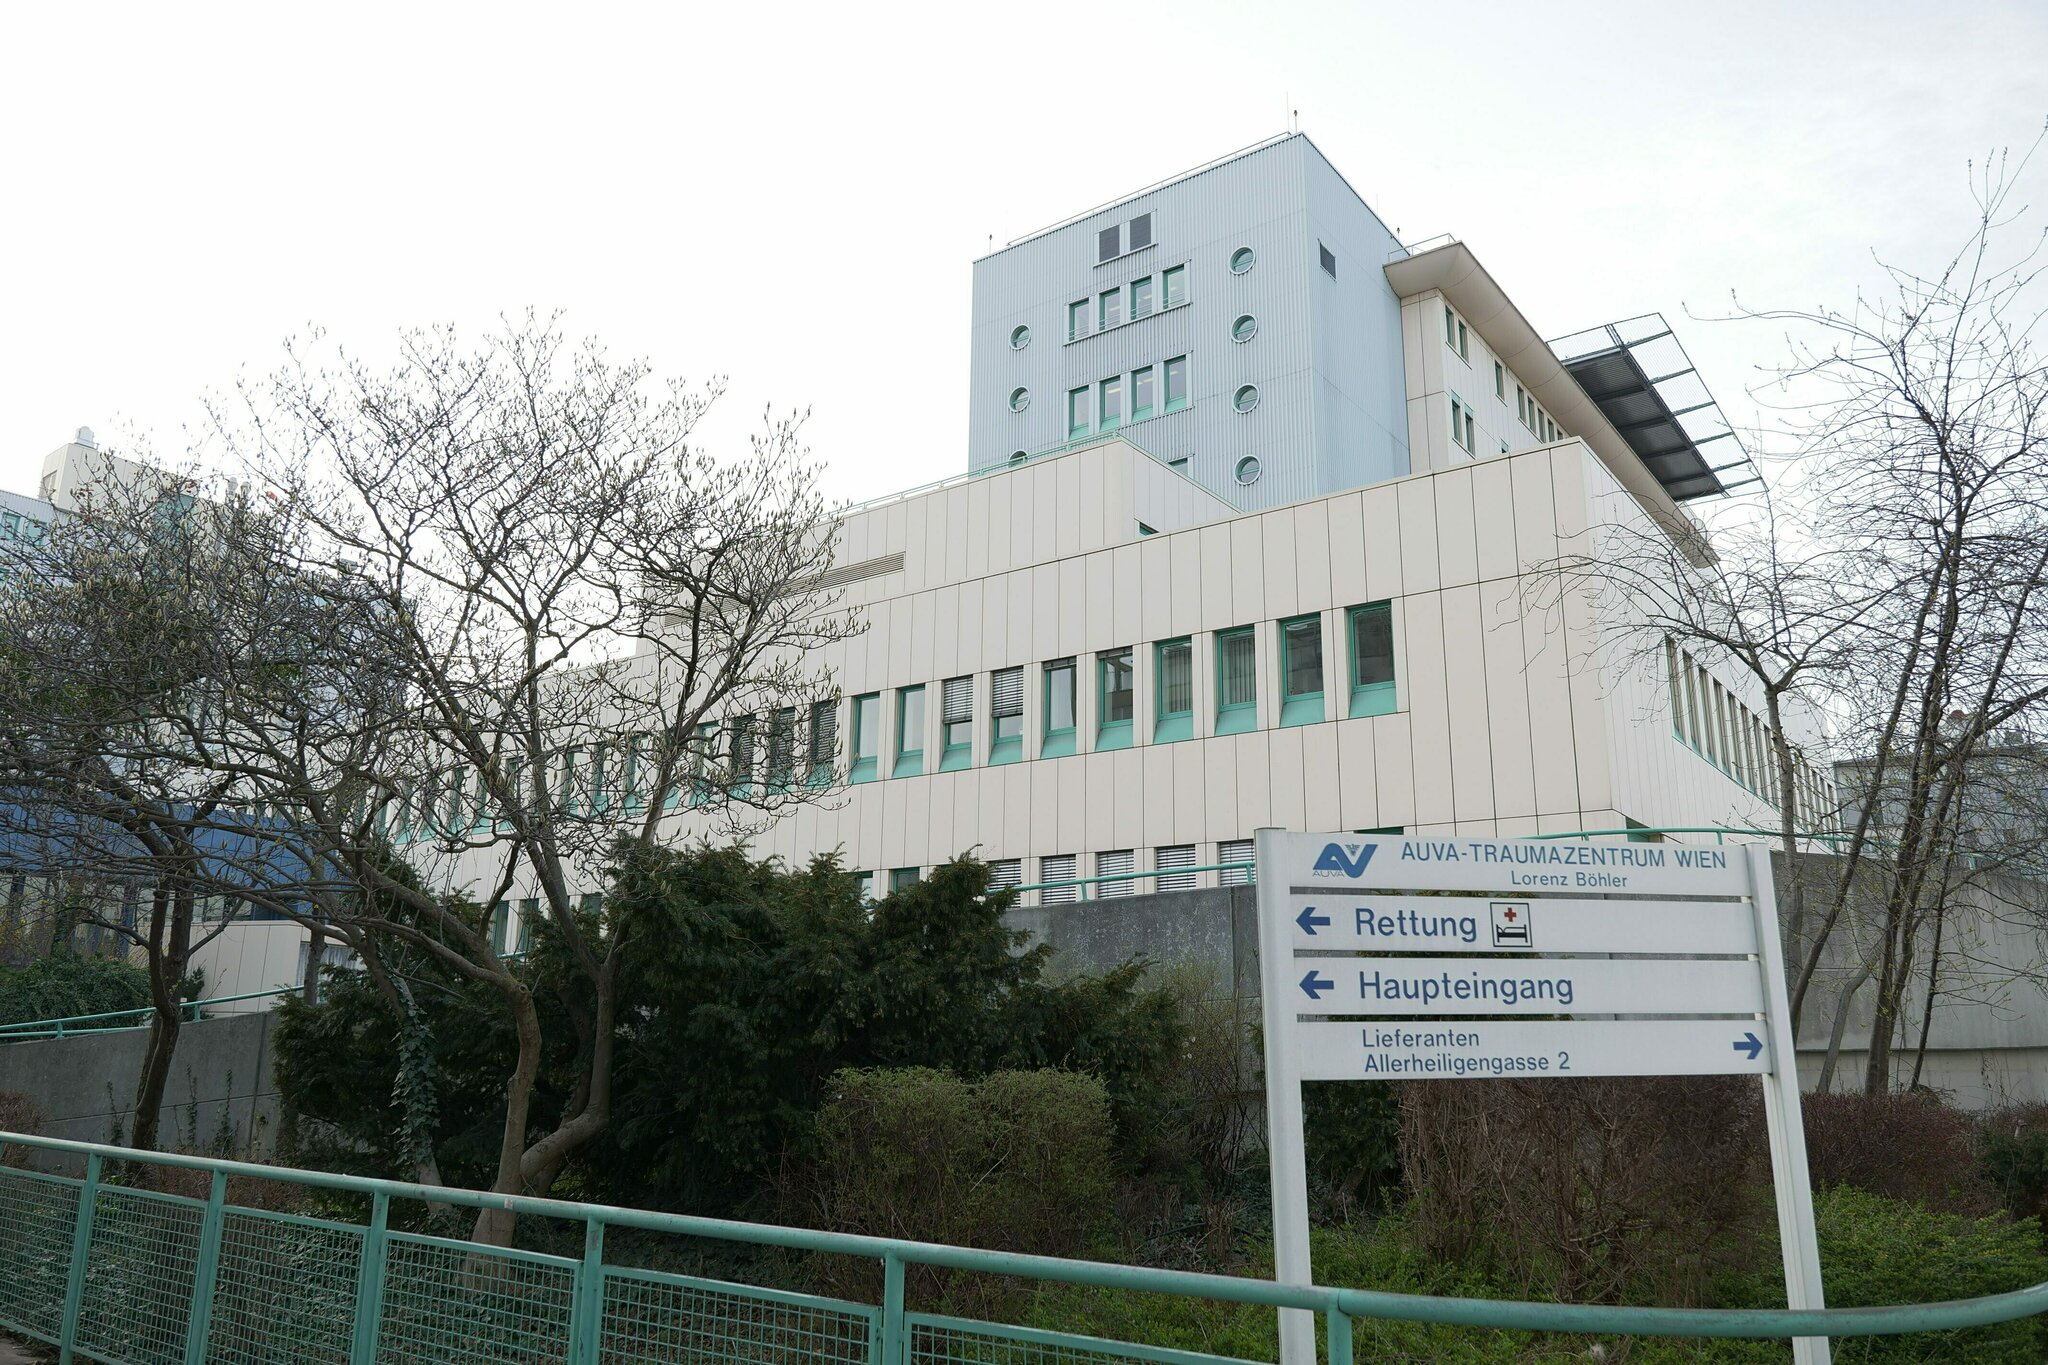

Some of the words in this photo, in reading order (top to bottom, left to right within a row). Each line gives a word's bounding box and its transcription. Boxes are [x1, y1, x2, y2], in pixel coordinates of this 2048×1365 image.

[1401, 842, 1665, 868] AUVA-TRAUMAZENTRUM
[1675, 850, 1727, 869] WIEN
[1511, 870, 1568, 887] Lorenz
[1575, 871, 1628, 888] Böhler
[1355, 907, 1477, 943] Rettung
[1359, 971, 1574, 1005] Haupteingang
[1362, 1028, 1480, 1048] Lieferanten
[1364, 1052, 1549, 1076] Allerheiligengasse
[1558, 1051, 1571, 1070] 2
